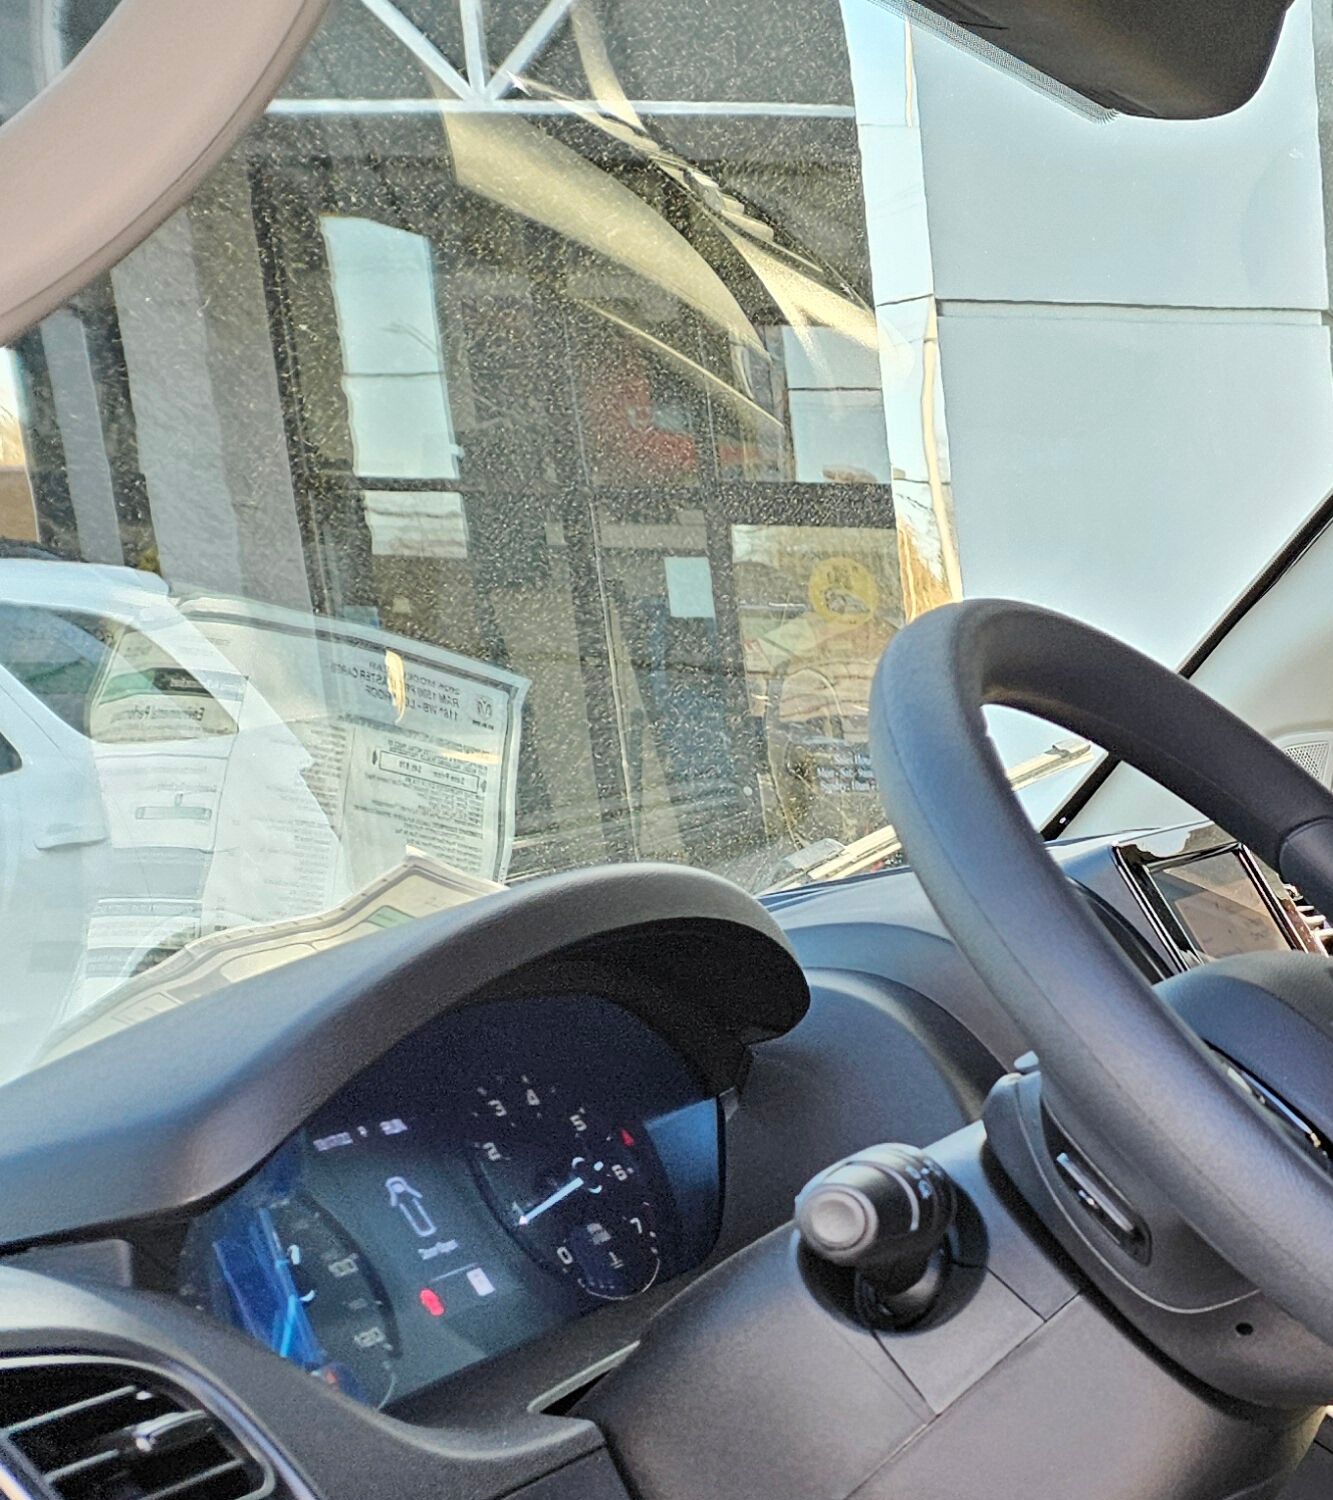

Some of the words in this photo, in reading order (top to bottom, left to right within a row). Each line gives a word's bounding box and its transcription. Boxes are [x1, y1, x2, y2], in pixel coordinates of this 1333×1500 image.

[526, 1088, 541, 1106] 4
[487, 1099, 508, 1117] 3
[569, 1114, 588, 1132] 5
[611, 1164, 629, 1181] 6
[630, 1216, 643, 1235] 7
[556, 1246, 574, 1265] 0
